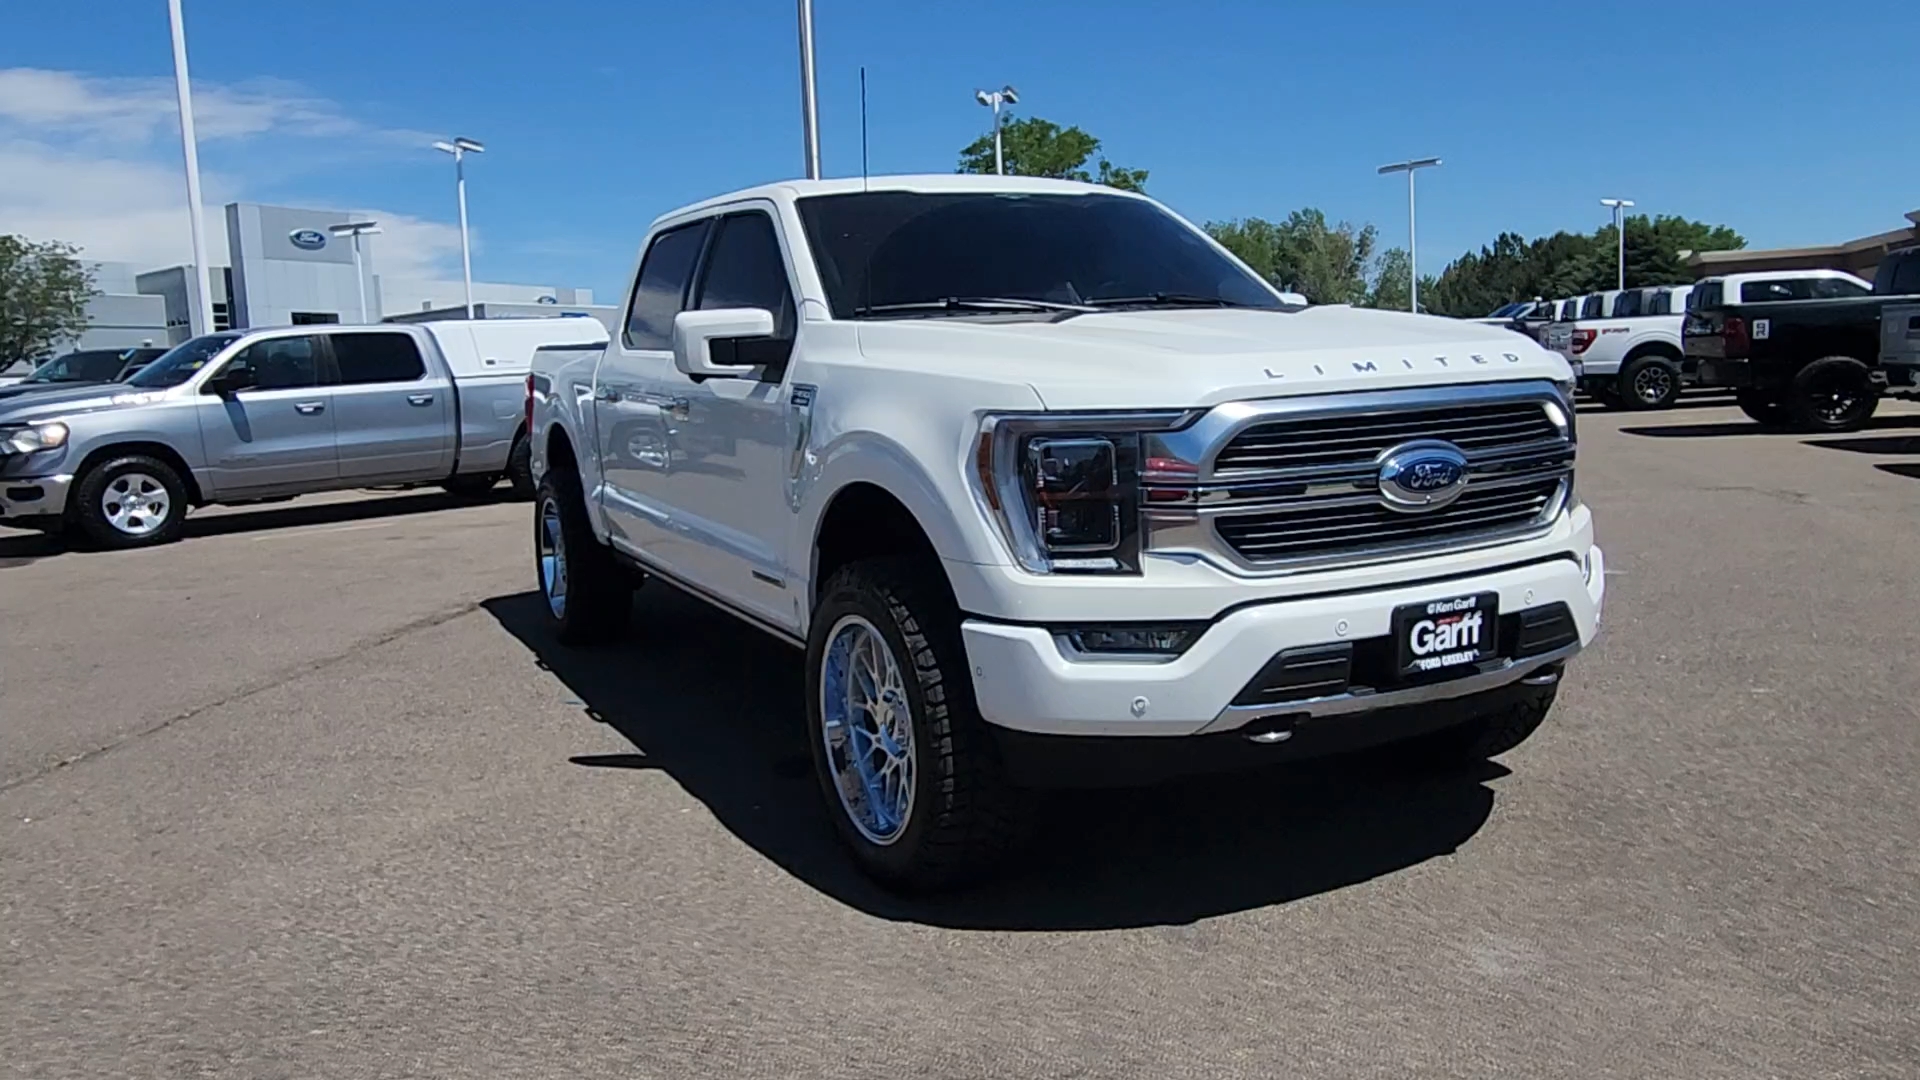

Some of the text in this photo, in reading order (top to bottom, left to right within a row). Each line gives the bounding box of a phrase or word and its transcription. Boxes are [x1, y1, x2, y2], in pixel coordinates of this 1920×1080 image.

[1263, 353, 1520, 380] LIMITED
[1411, 463, 1452, 488] Ford
[1435, 596, 1476, 613] Ken Garff
[1410, 610, 1482, 655] Garff
